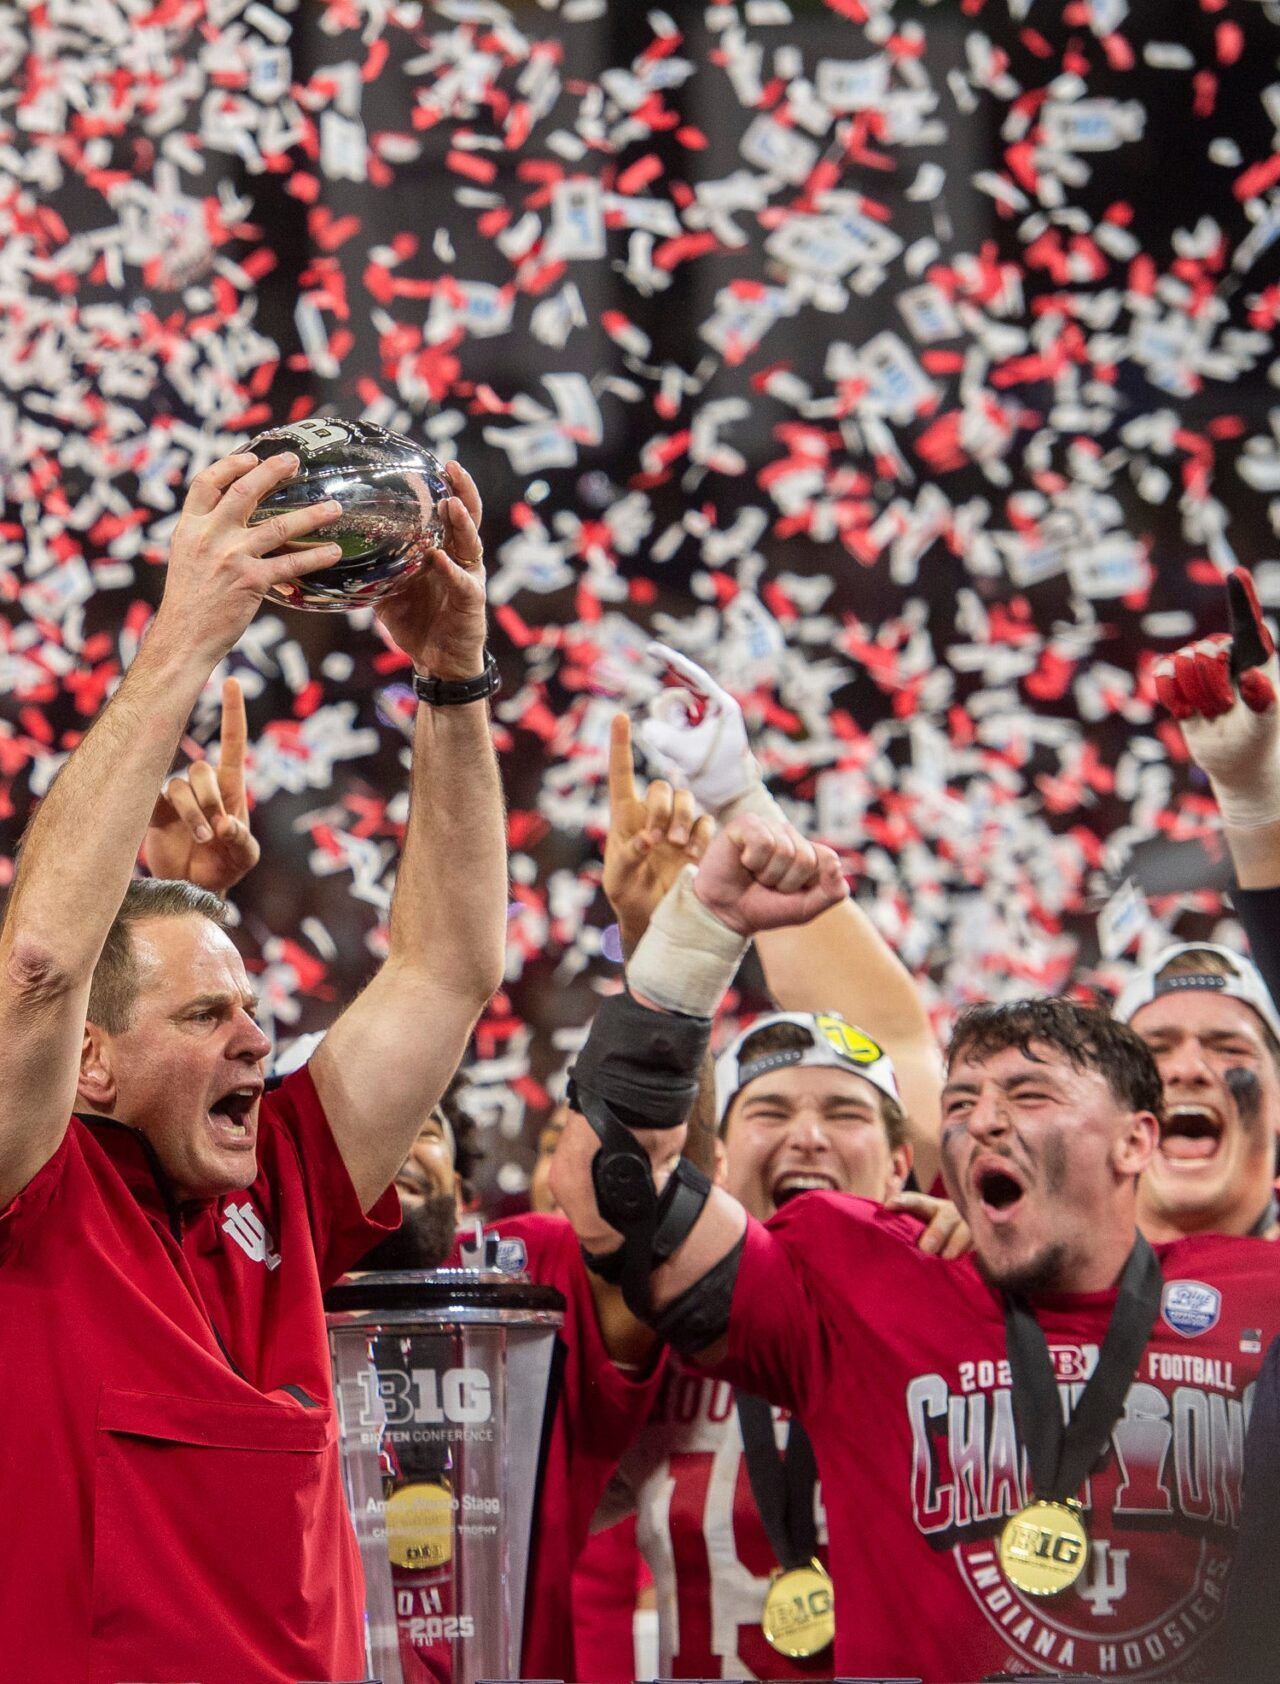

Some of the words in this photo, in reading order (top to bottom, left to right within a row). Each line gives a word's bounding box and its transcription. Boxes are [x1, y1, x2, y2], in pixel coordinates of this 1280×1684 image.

[958, 1359, 1013, 1392] 202
[1148, 1352, 1236, 1393] FOOTBALL
[412, 1428, 494, 1442] CONFERENCE
[462, 1493, 500, 1514] Stagg
[458, 1525, 498, 1536] TROPHY
[967, 1551, 1074, 1669] INDIANA
